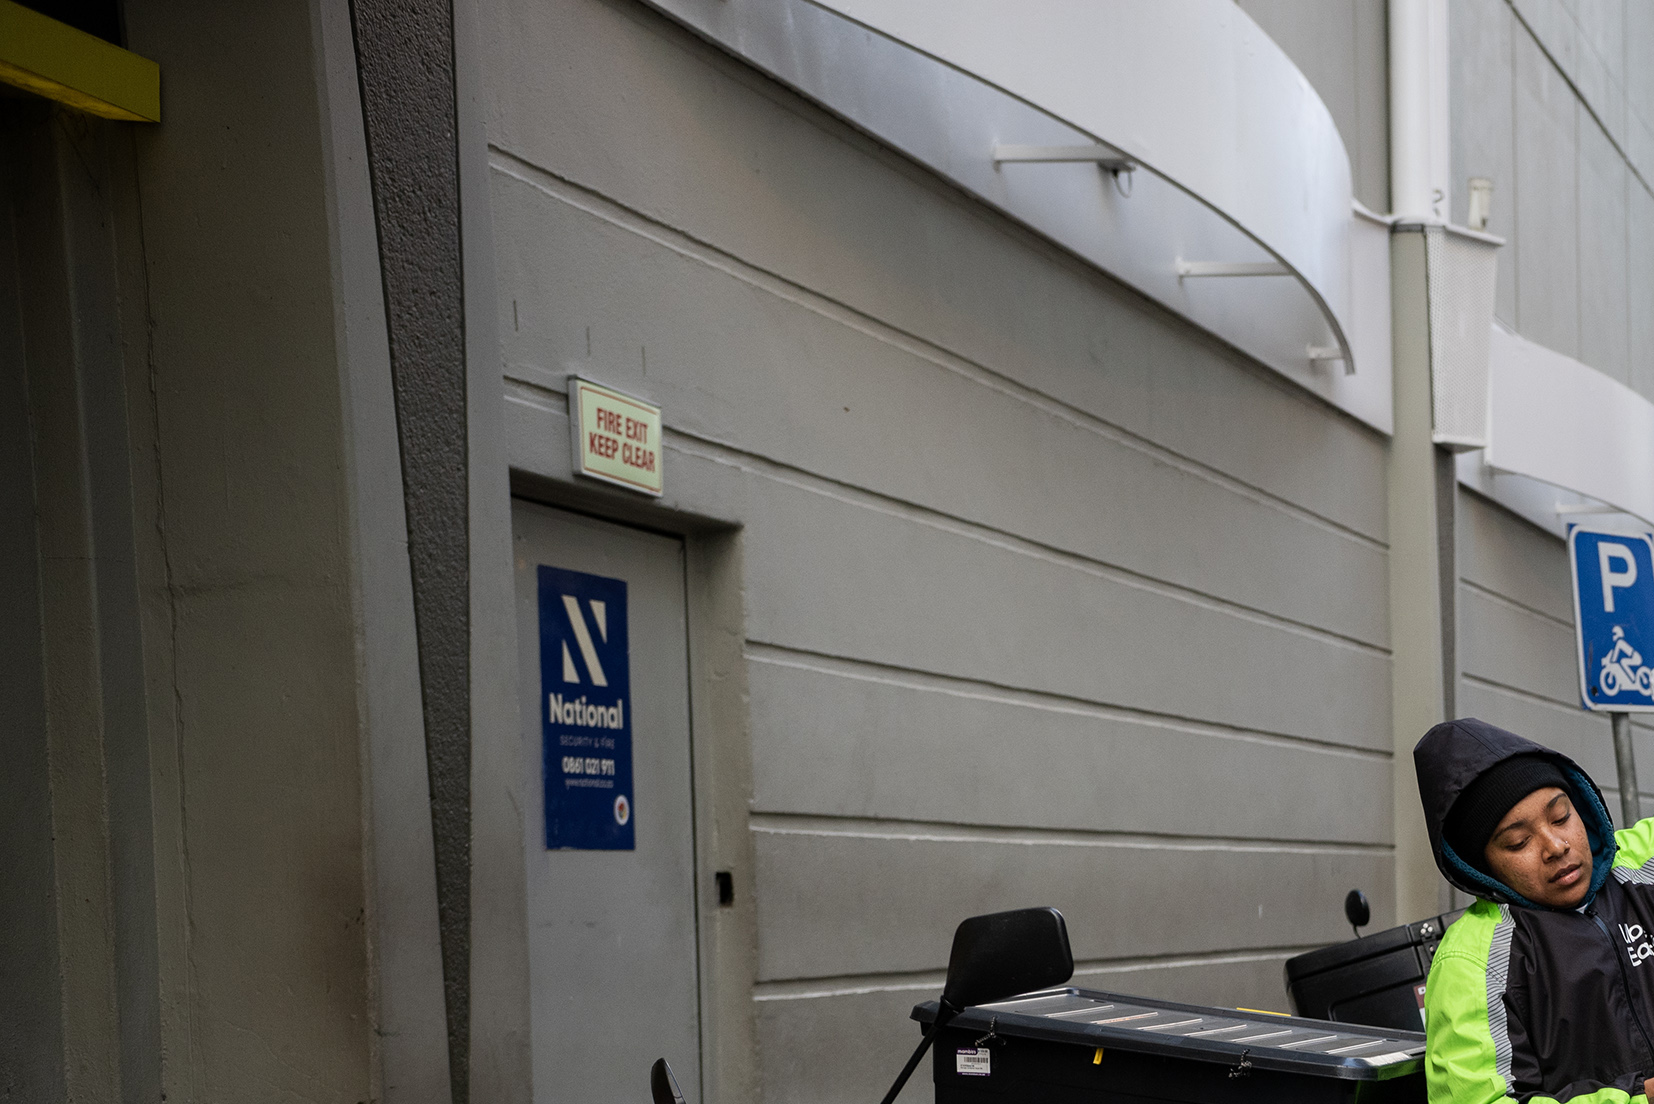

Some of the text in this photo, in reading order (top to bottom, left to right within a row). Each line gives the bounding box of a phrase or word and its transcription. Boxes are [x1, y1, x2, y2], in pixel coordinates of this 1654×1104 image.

[597, 408, 648, 445] FIRE EXIT
[589, 432, 655, 474] KEEP CLEAR
[1597, 541, 1638, 613] P
[549, 692, 623, 729] National
